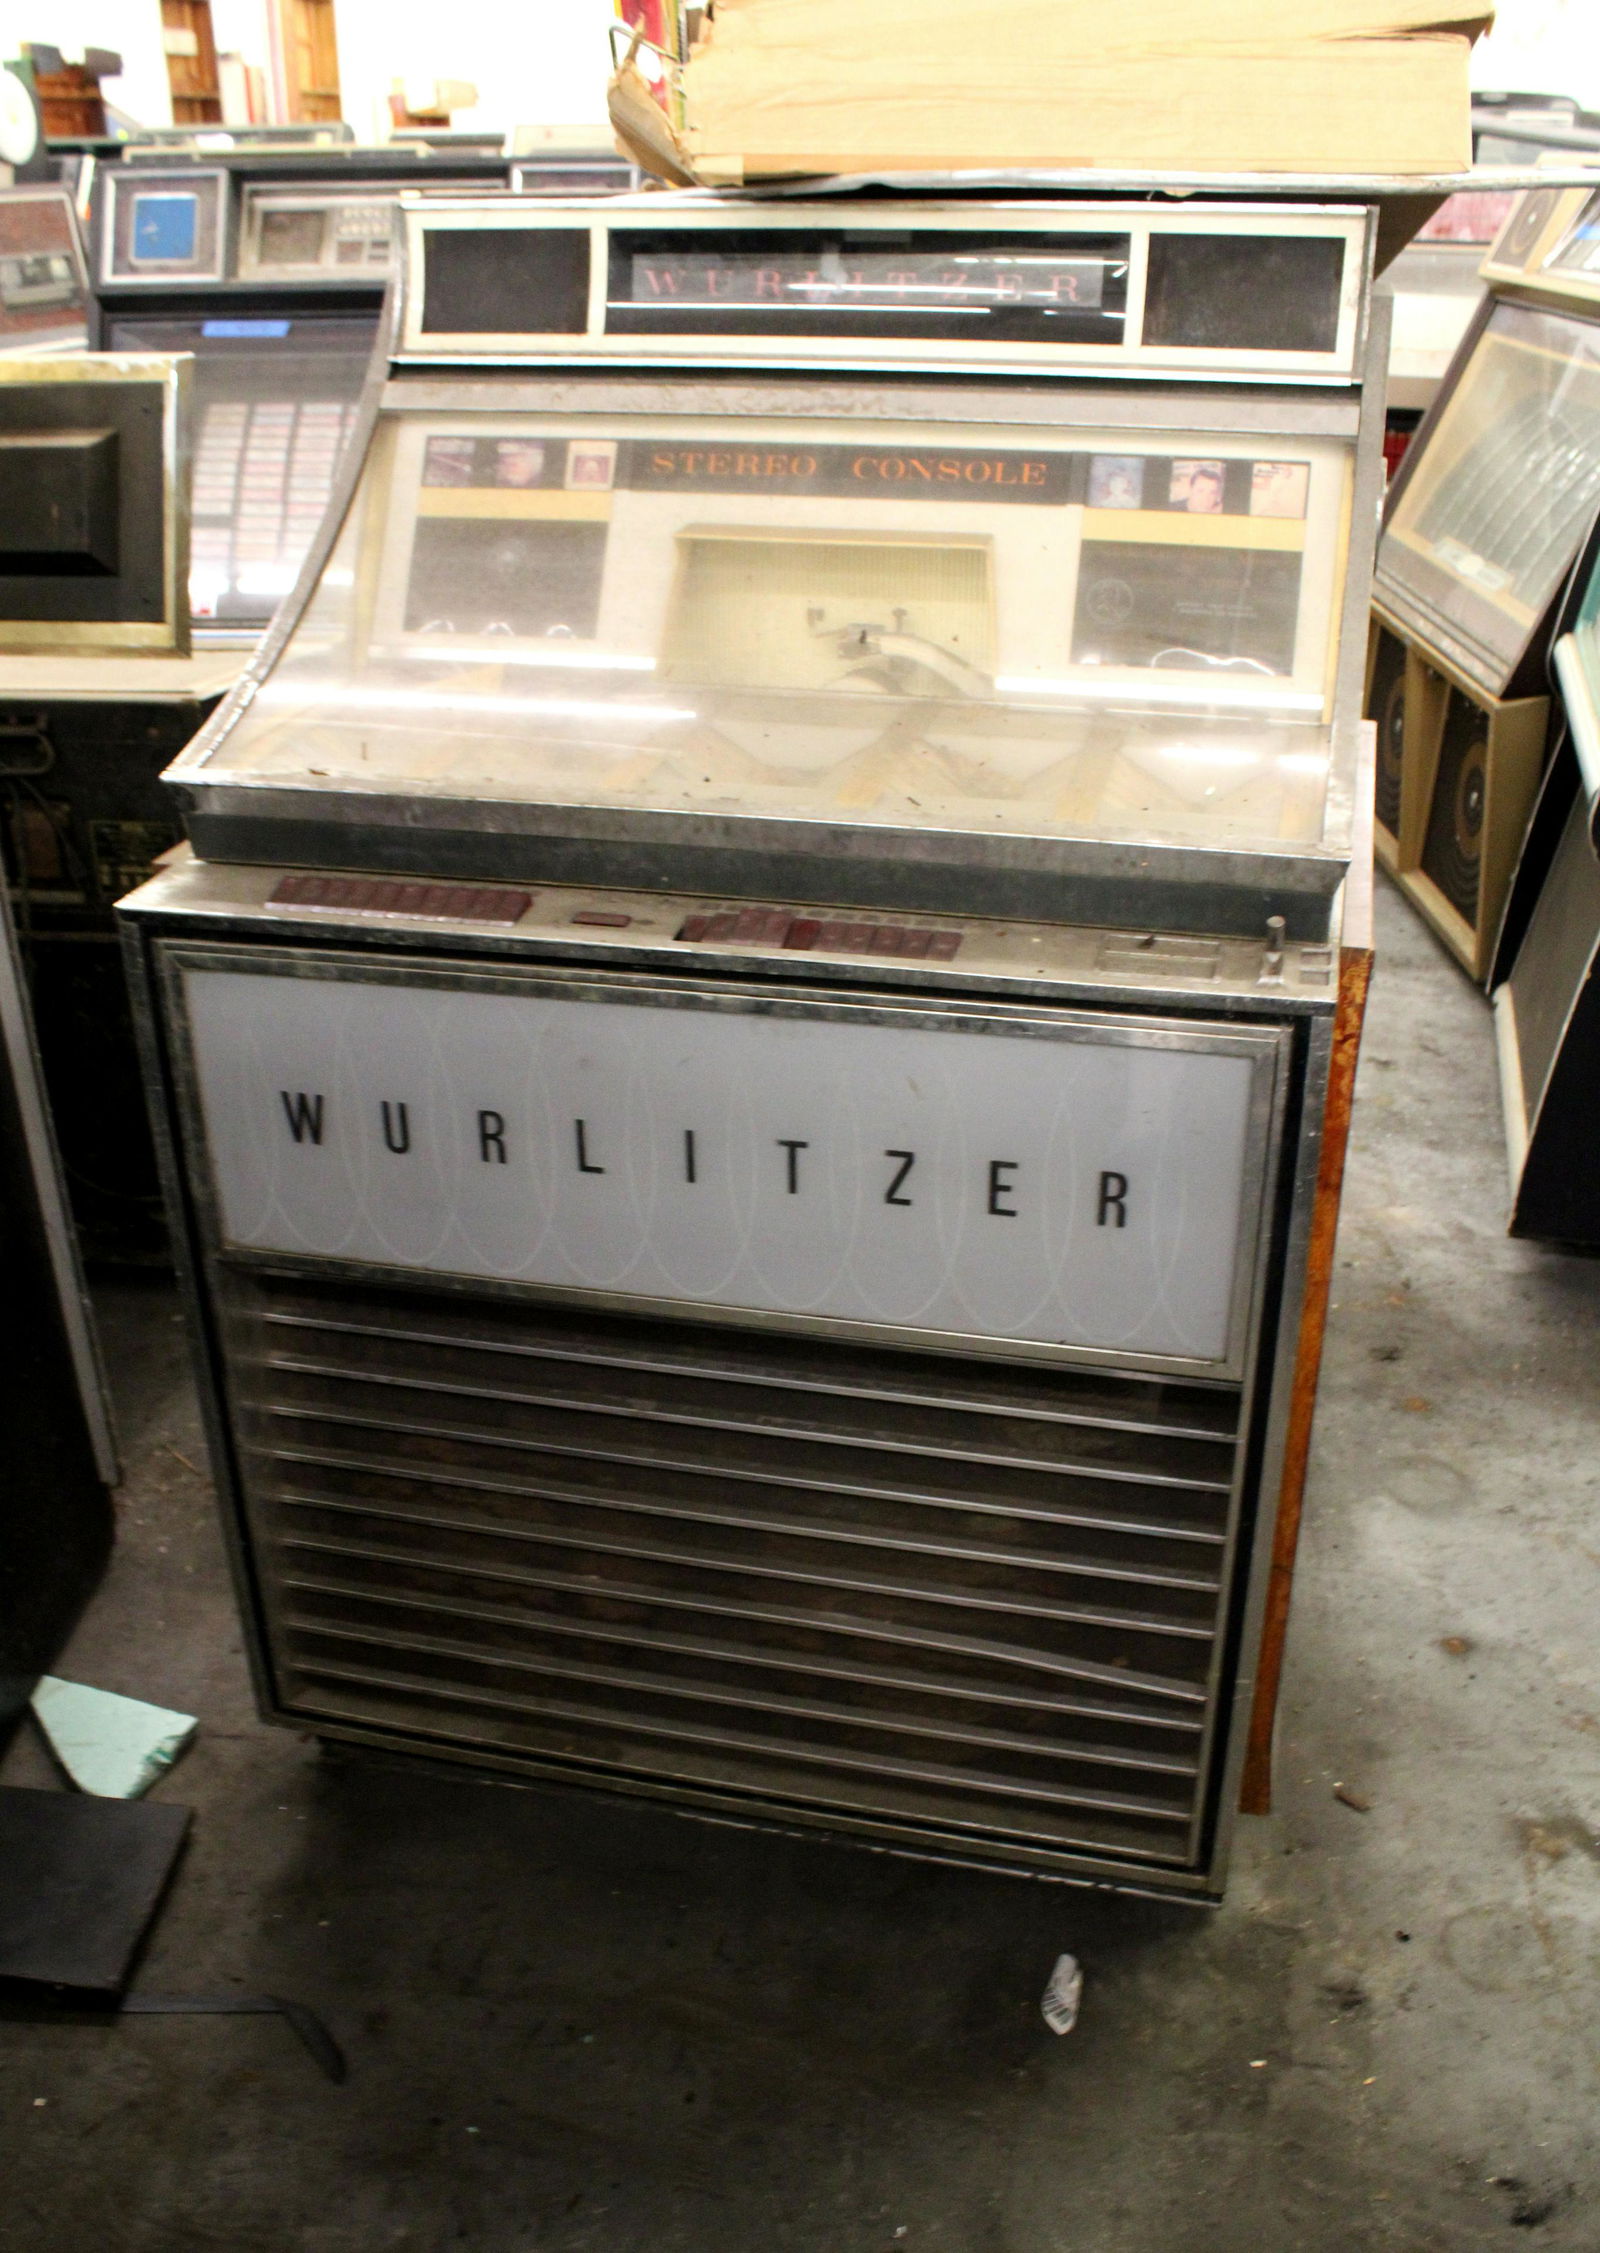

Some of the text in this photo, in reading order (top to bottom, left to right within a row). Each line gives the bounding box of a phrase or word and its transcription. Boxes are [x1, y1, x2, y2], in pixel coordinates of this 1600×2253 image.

[651, 452, 1048, 486] STEREO CONSOLE
[281, 1090, 1129, 1228] WURLITZER
